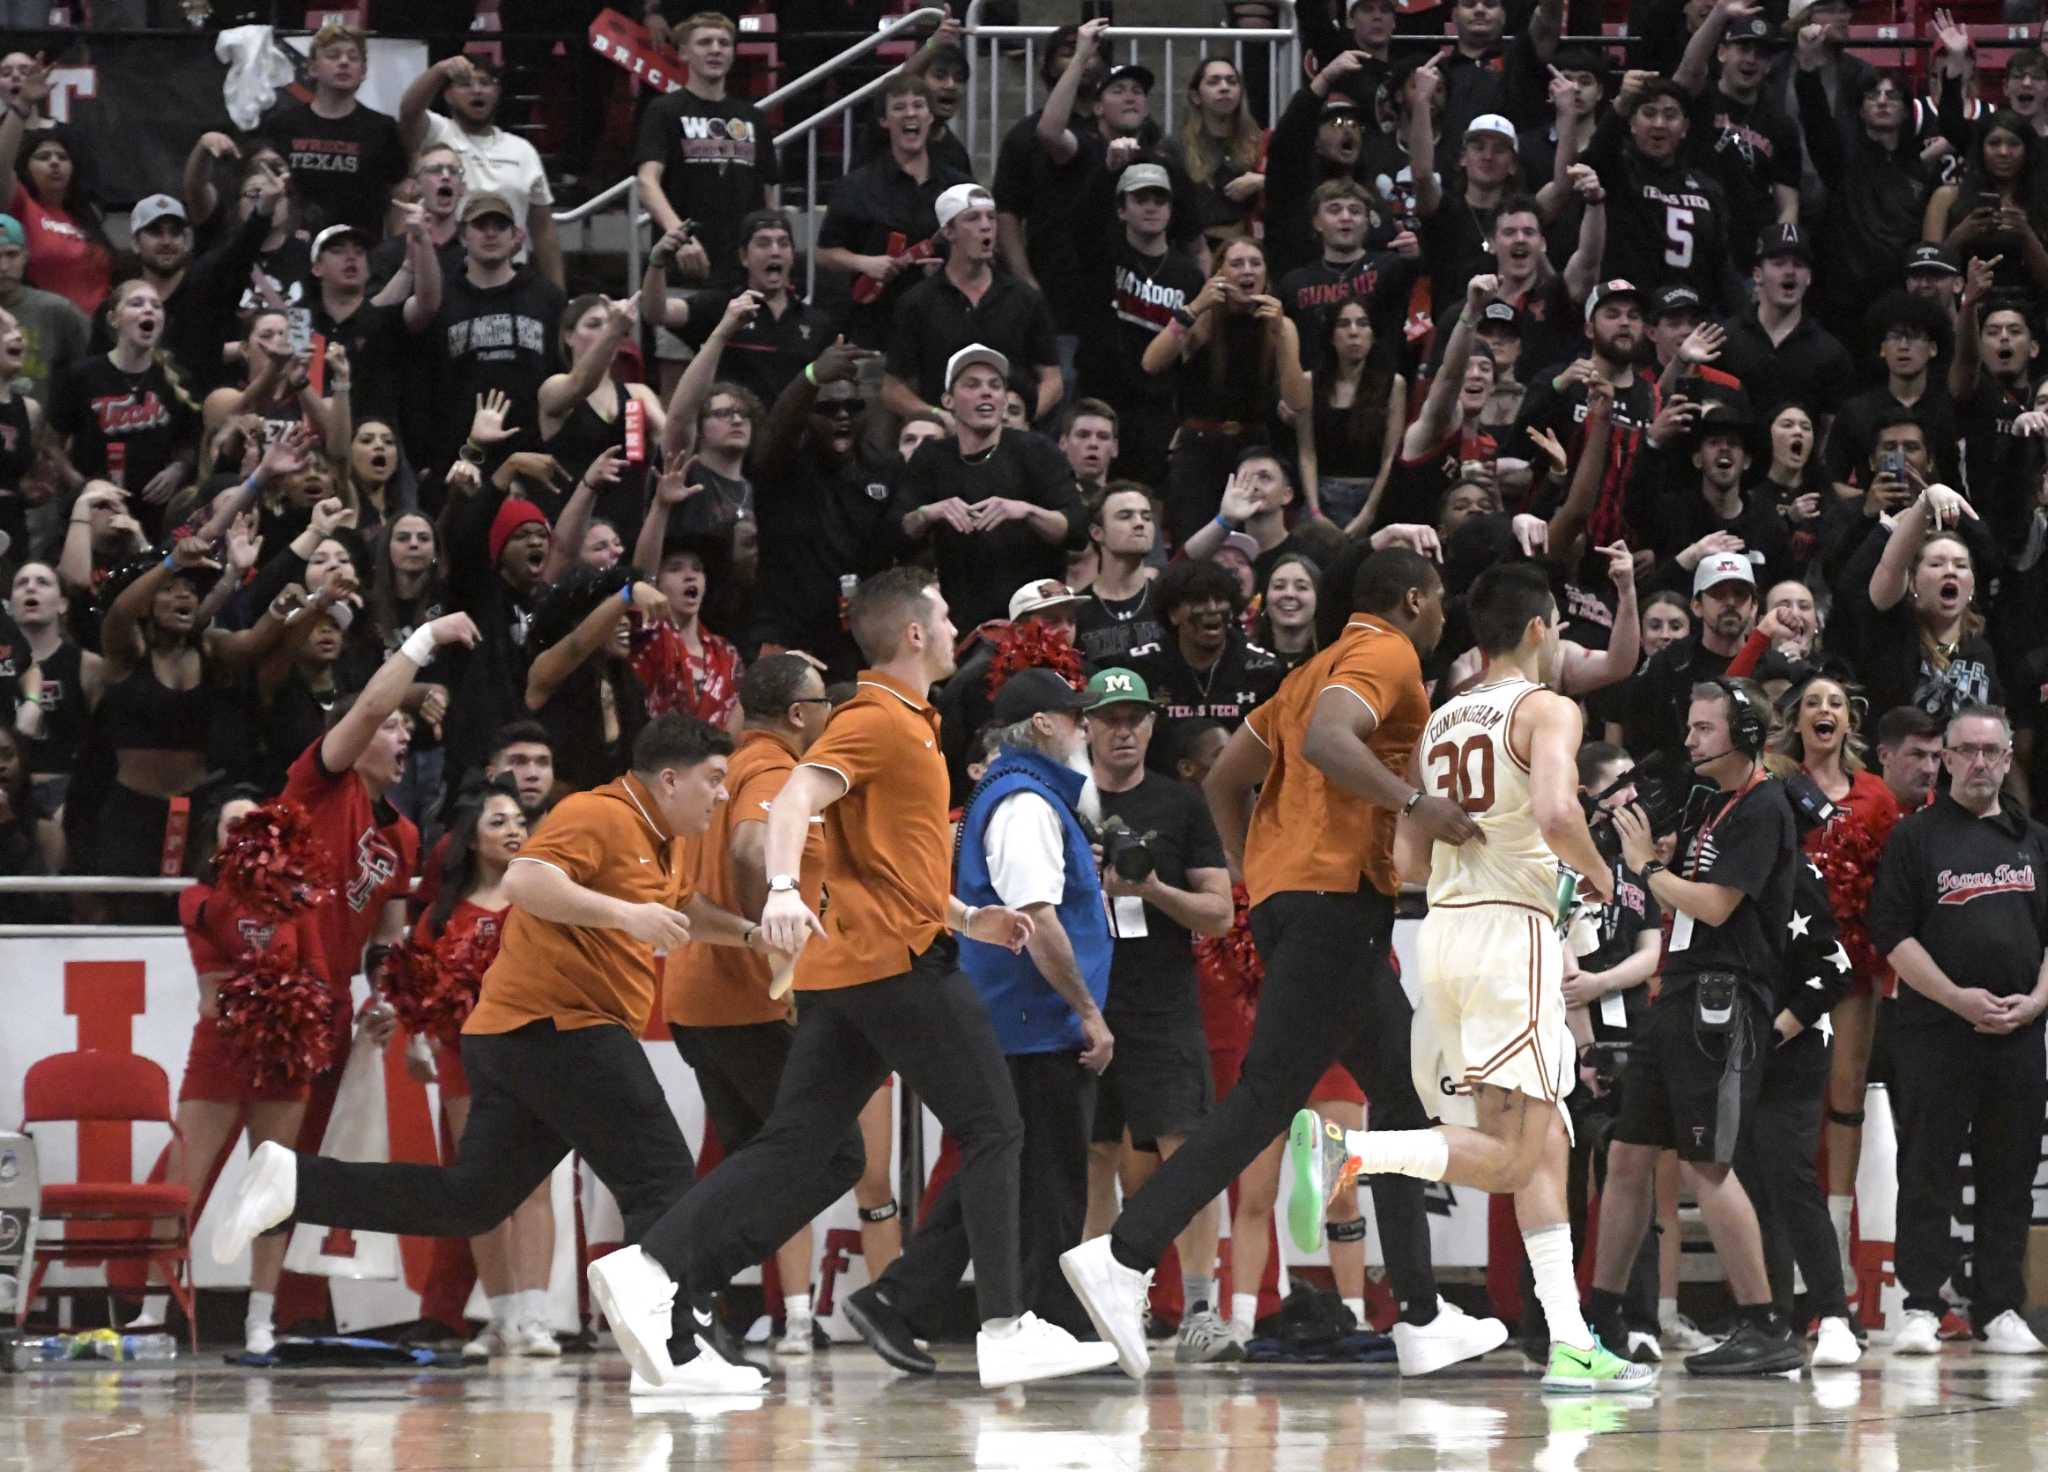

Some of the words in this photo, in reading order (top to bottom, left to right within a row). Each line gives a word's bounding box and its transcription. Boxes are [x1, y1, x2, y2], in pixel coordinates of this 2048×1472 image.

[289, 152, 358, 173] TEXAS
[1665, 206, 1695, 269] 5
[1353, 271, 1378, 296] UP
[1104, 674, 1134, 693] M
[1210, 704, 1240, 717] TECH
[1429, 704, 1505, 744] CUNNINGHAM
[1427, 734, 1496, 813] 30
[1937, 868, 1993, 894] Texas
[1994, 864, 2036, 890] Tech
